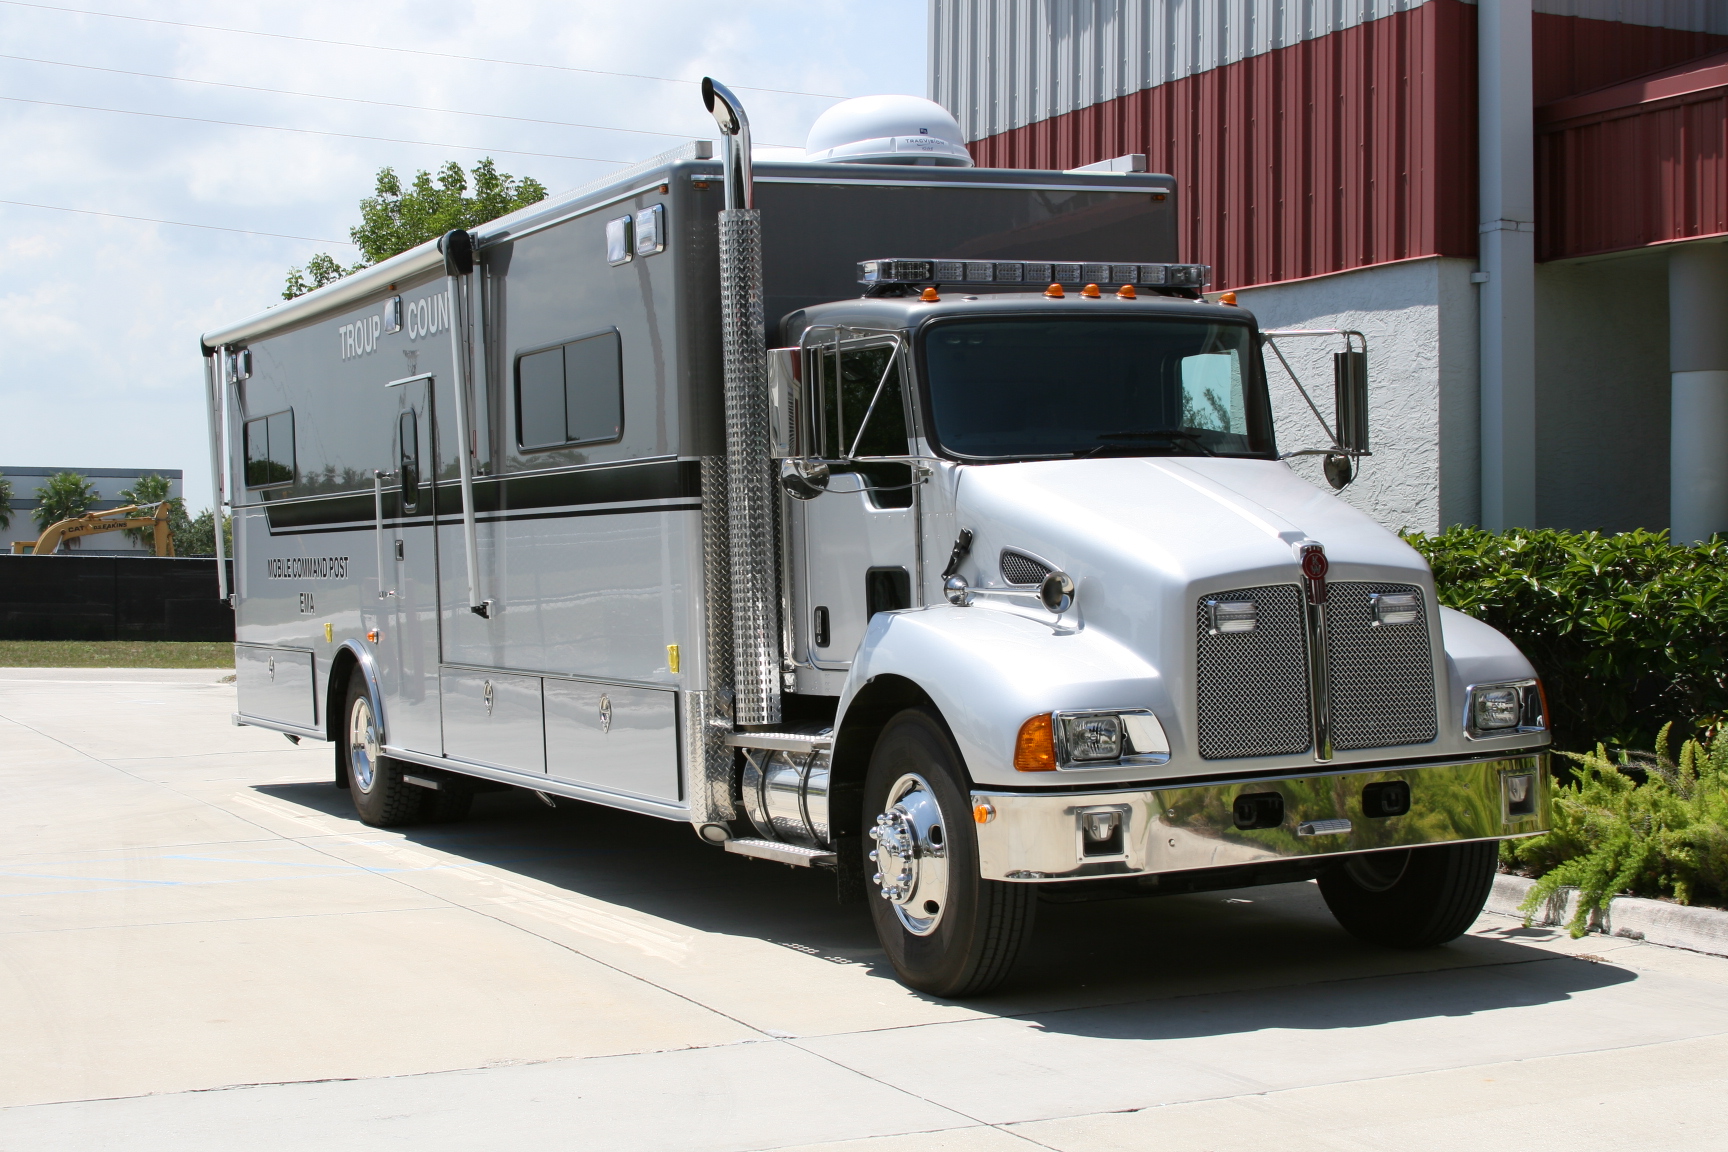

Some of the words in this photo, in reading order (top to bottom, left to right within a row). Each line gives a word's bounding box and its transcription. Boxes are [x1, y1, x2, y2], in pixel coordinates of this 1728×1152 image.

[339, 314, 381, 360] TROUP
[407, 291, 450, 340] COUN
[68, 525, 85, 533] CAT
[267, 558, 292, 579] MOBILE
[292, 557, 328, 579] COMMAND
[329, 556, 349, 579] POST
[299, 592, 316, 615] EMA
